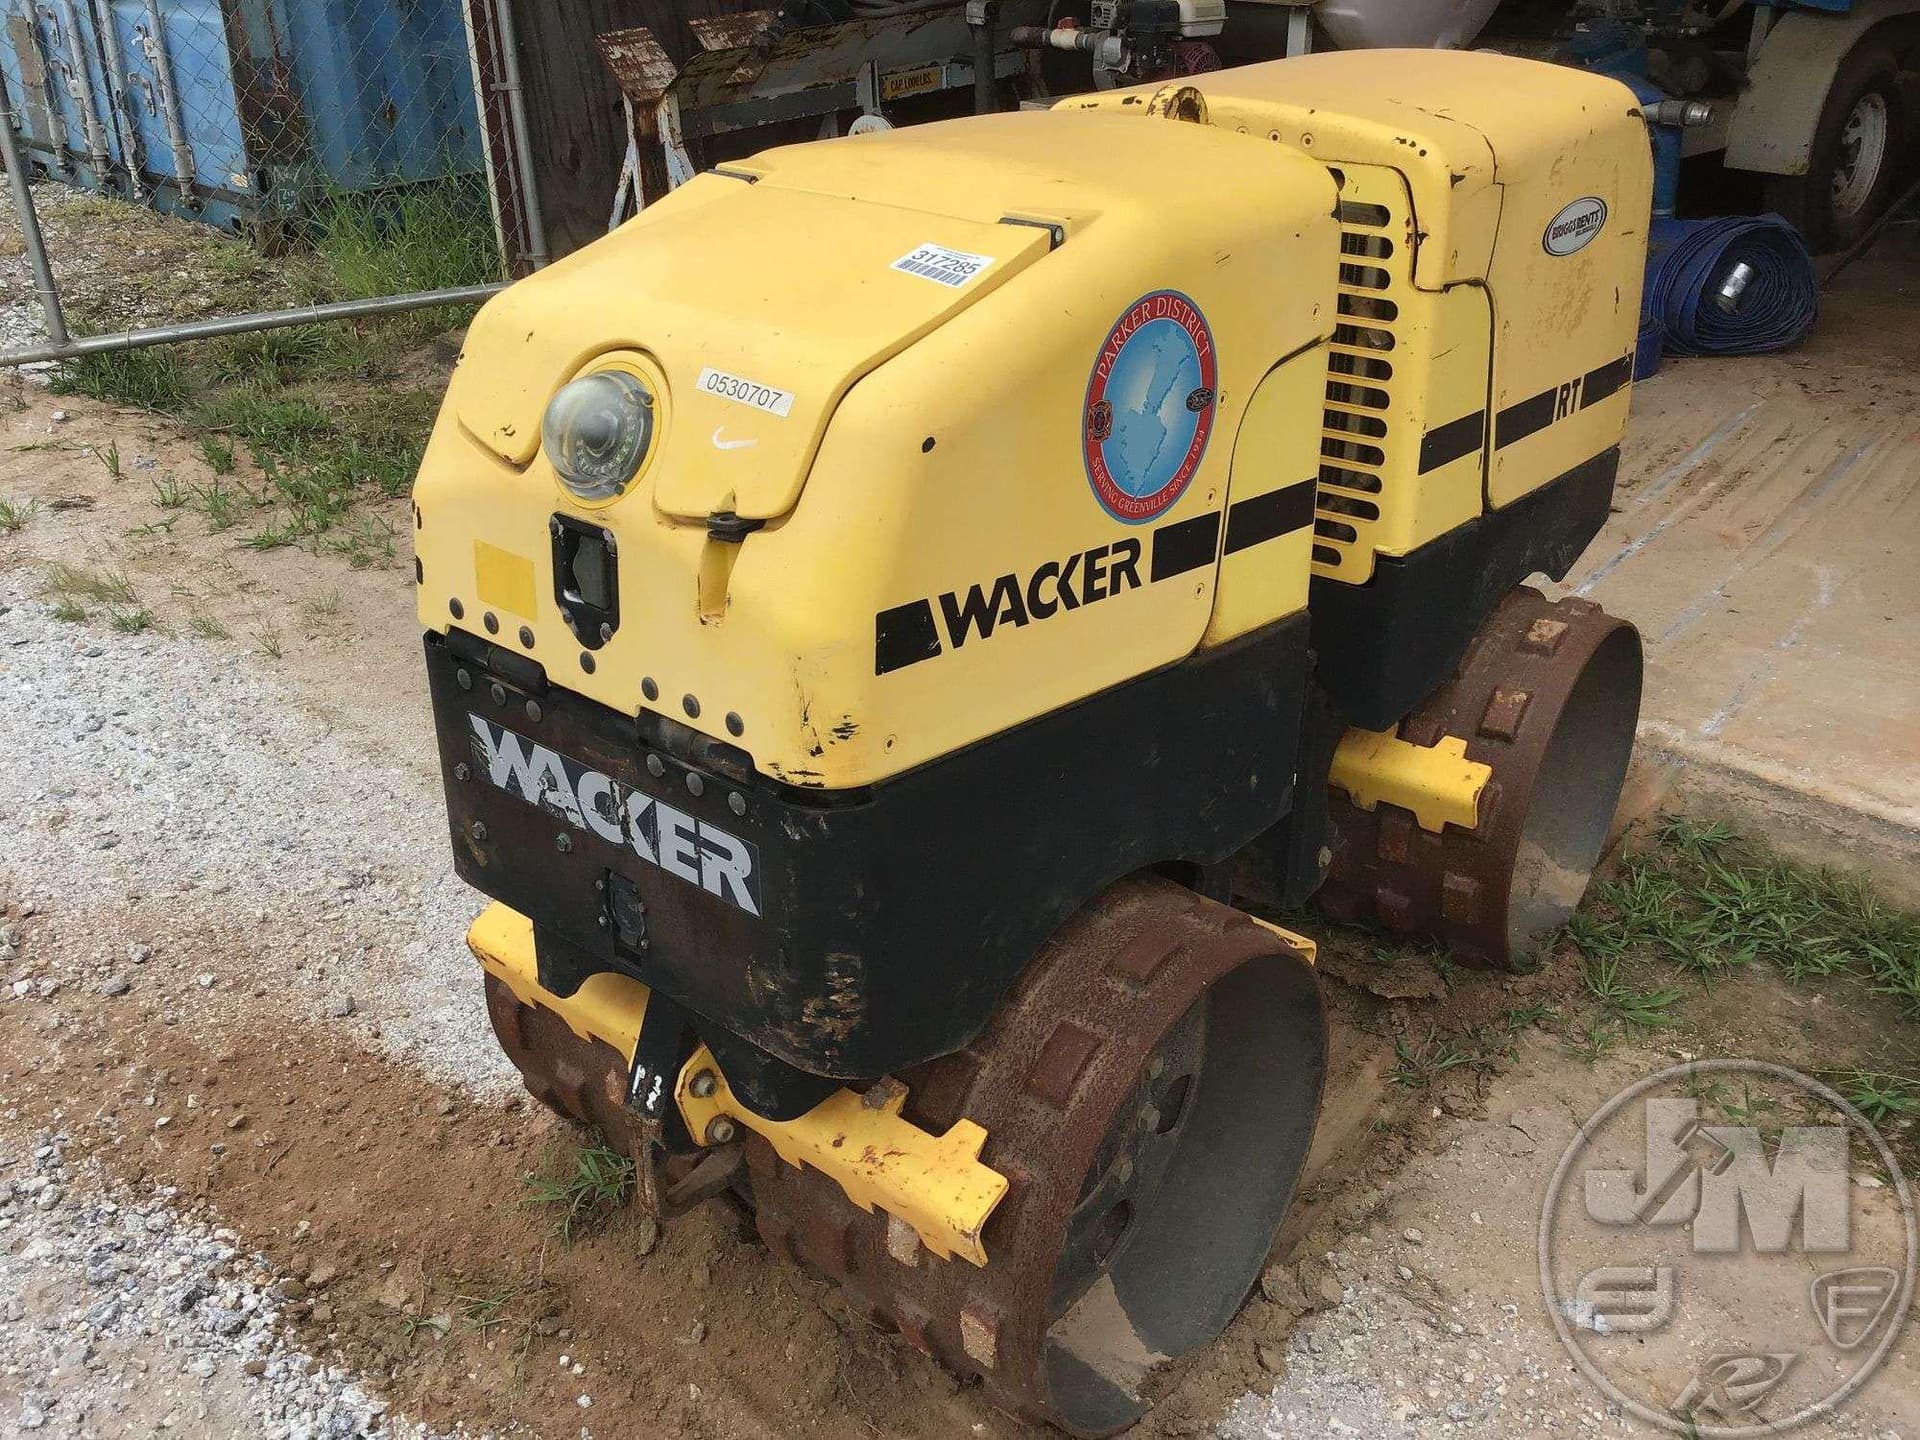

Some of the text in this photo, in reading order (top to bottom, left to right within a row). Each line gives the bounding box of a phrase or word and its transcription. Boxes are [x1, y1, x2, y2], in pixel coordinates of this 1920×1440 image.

[911, 250, 981, 274] 317285
[1097, 297, 1210, 379] PARKER DISTRICT
[706, 373, 782, 409] 0530707
[1556, 376, 1581, 421] RT
[1092, 457, 1118, 504] SERVING
[1118, 490, 1169, 513] GREENVILLE
[938, 537, 1142, 649] WACKER
[468, 712, 760, 917] WACKER
